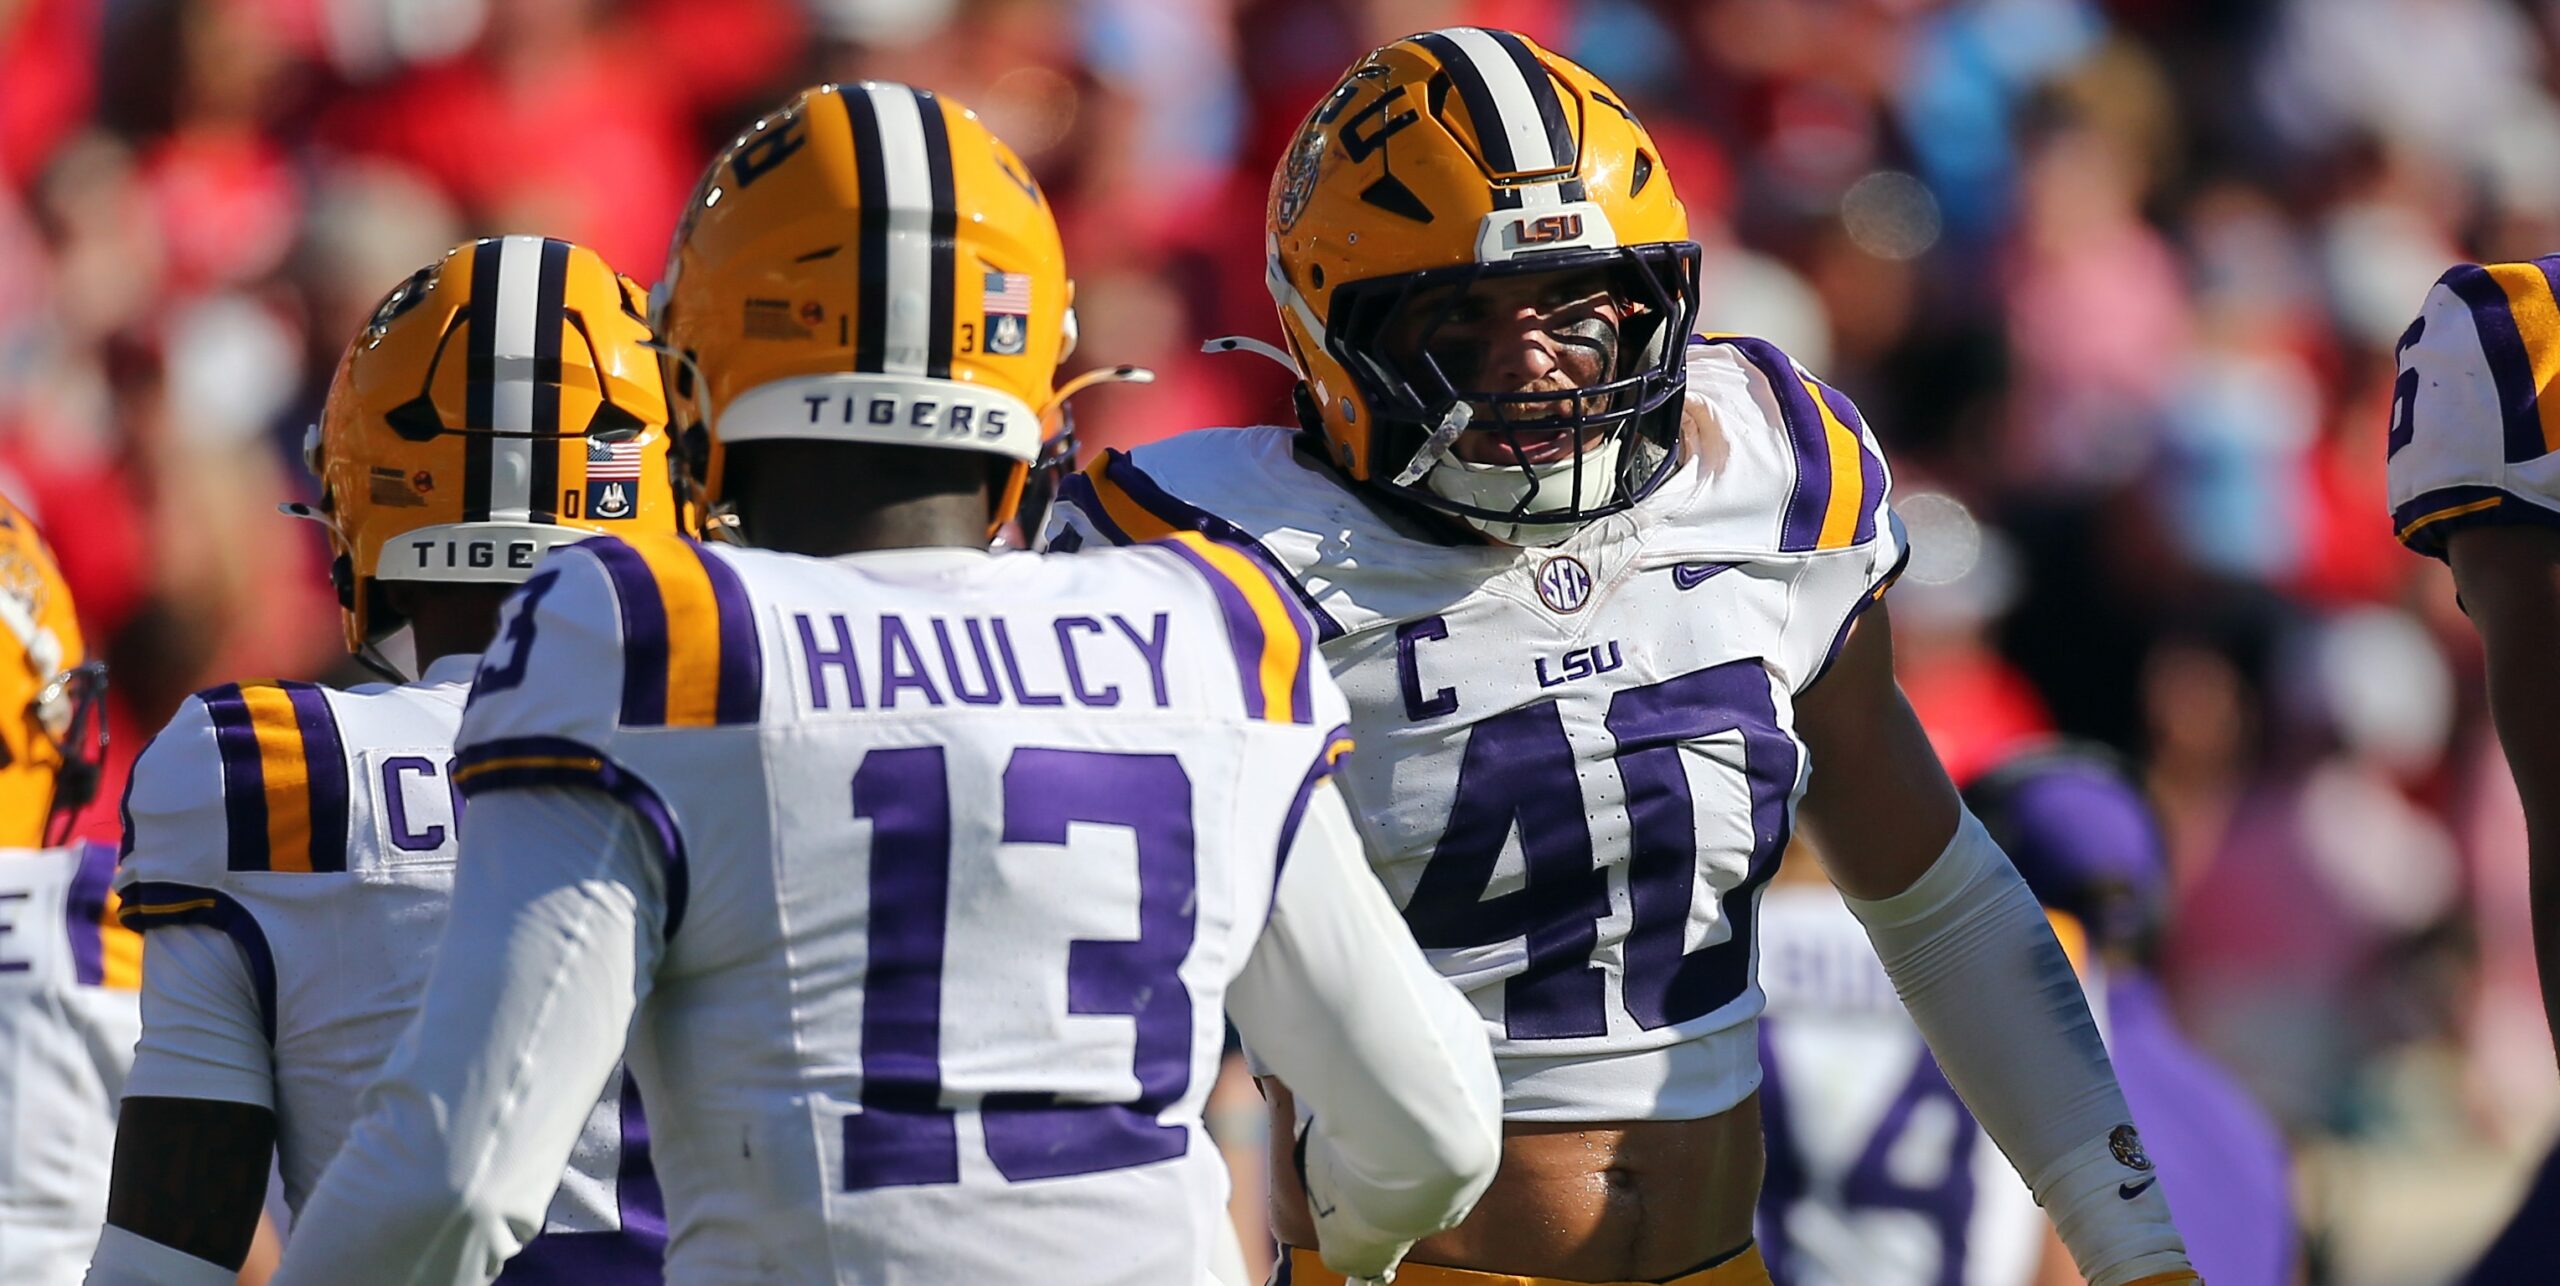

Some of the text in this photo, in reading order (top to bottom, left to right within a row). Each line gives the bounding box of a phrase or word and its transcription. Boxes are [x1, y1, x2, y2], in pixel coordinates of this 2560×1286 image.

[1515, 213, 1583, 244] LSU
[961, 324, 974, 352] 3
[804, 397, 1007, 436] TIGERS
[412, 541, 562, 568] TIGE
[1541, 558, 1590, 611] SEC
[467, 569, 561, 706] 3
[795, 613, 1169, 708] HAULCY
[1397, 614, 1459, 722] C
[1535, 640, 1622, 688] LSU
[382, 757, 461, 851] C
[1403, 656, 1798, 1040] 40
[844, 746, 1197, 1192] 13
